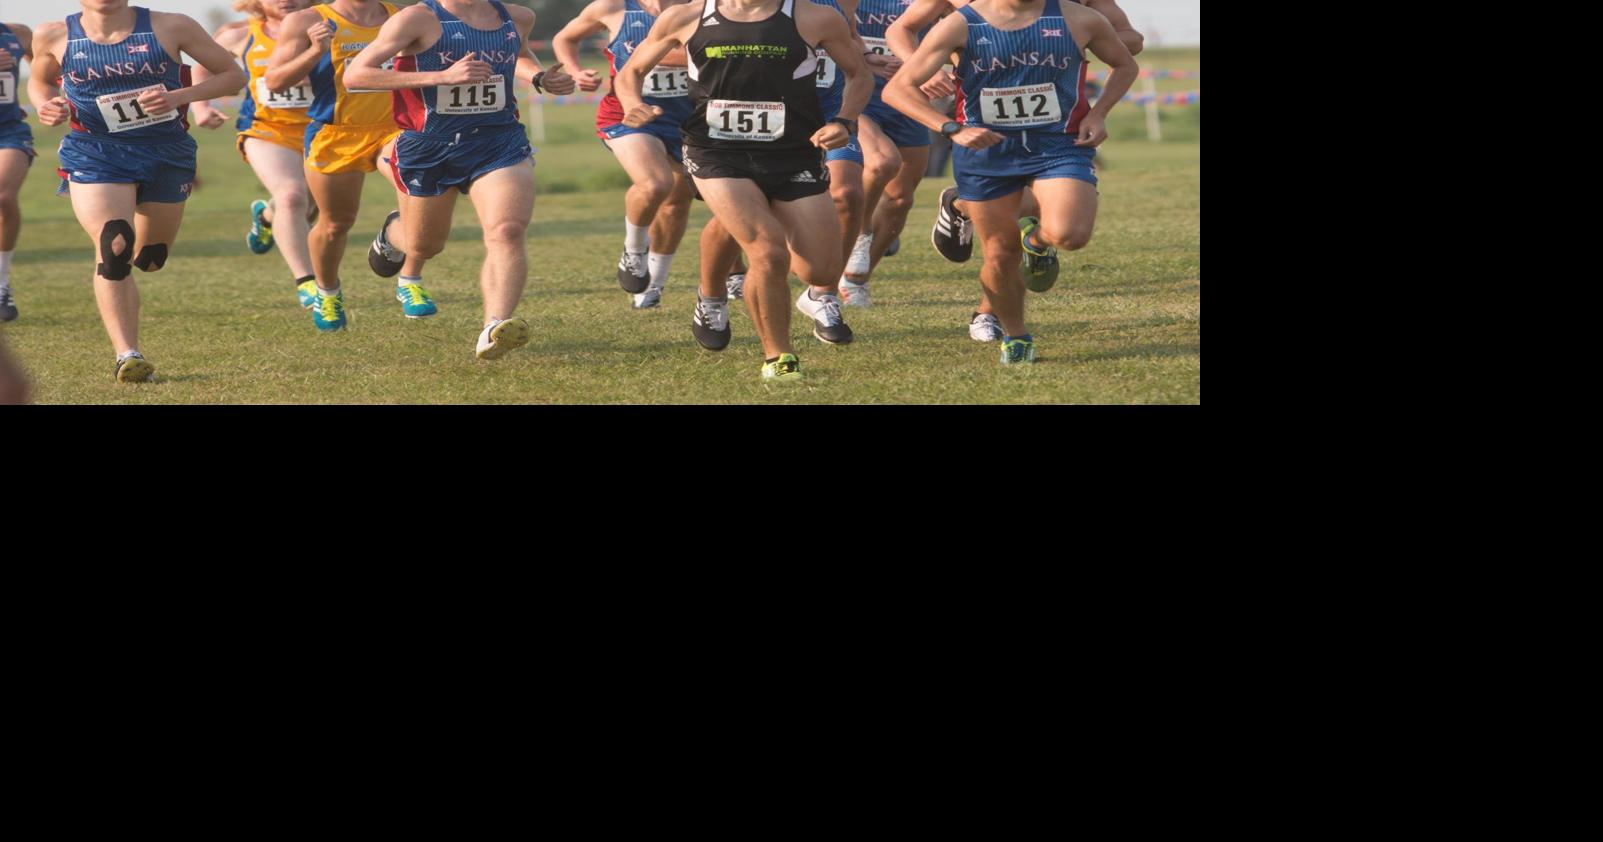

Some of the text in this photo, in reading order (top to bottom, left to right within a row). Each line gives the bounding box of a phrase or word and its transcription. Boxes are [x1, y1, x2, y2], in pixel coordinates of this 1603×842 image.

[67, 61, 168, 85] KANSAS
[971, 51, 1072, 74] KANSAS
[650, 71, 688, 91] 113
[995, 88, 1026, 97] TIMMONS
[449, 85, 497, 107] 115
[993, 94, 1050, 119] 112
[112, 99, 149, 123] 11
[719, 110, 771, 133] 151
